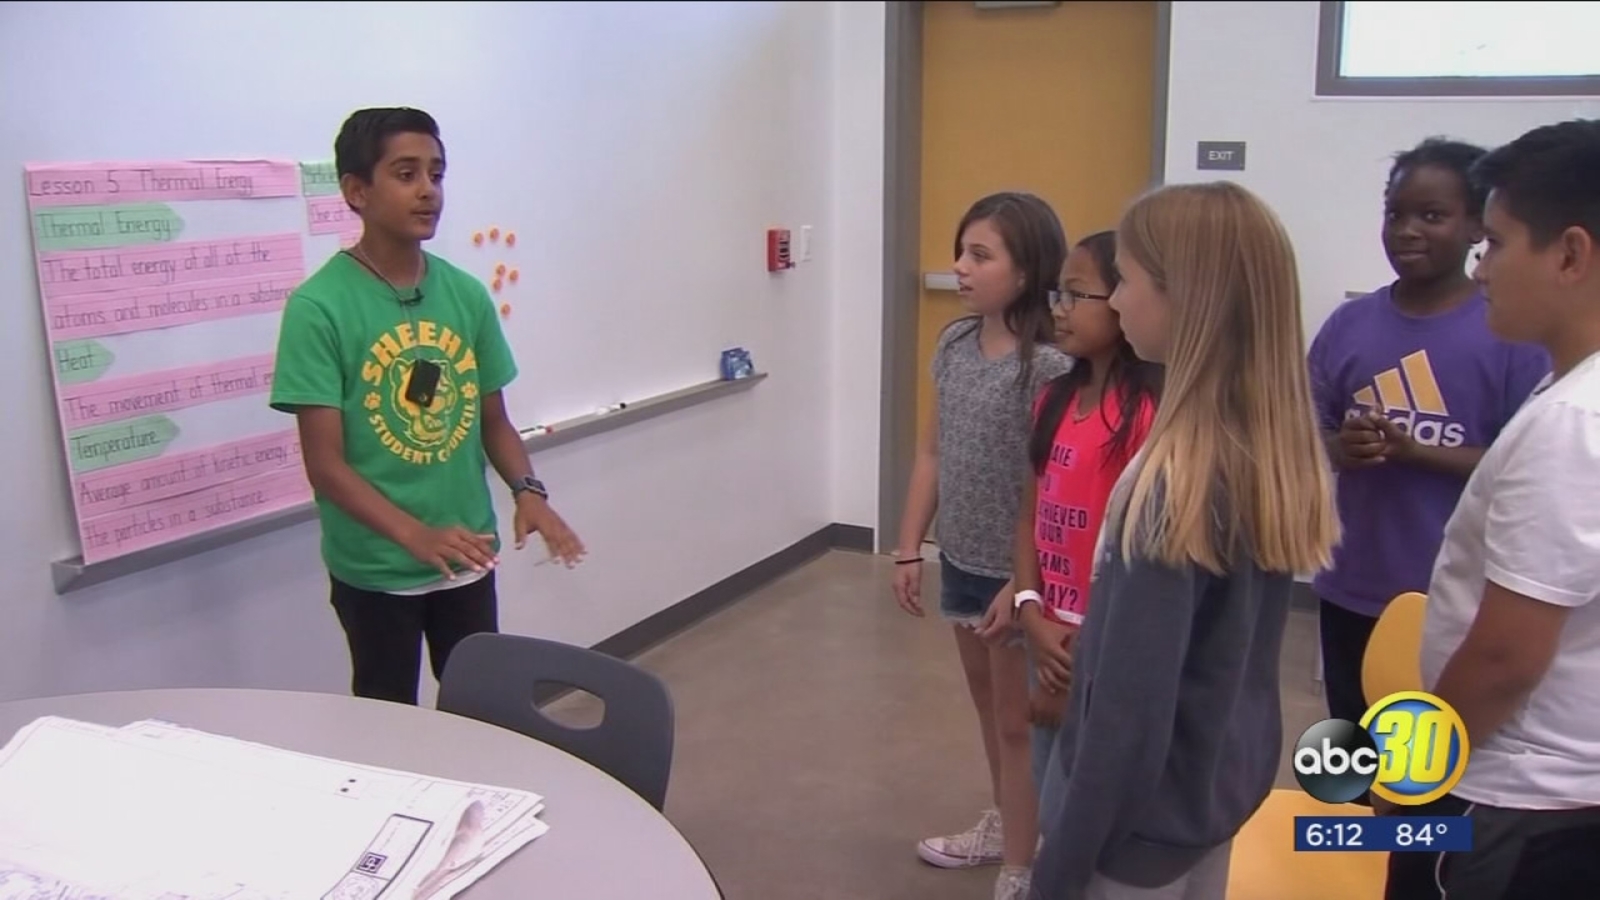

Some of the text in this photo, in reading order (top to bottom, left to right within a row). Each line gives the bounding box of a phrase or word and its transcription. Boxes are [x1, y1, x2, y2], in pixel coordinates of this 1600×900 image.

[1209, 150, 1235, 161] EXIT
[29, 167, 253, 197] Lesson 5 Thermal Energy
[36, 211, 171, 241] Thermal Energy
[42, 241, 271, 284] The total energy of all of the
[54, 305, 106, 330] atoms
[115, 297, 140, 321] and
[149, 290, 208, 316] molecules
[215, 294, 228, 308] in
[231, 293, 241, 306] a
[59, 348, 95, 373] Heat
[362, 320, 477, 387] SHEEHY
[64, 397, 100, 421] The
[108, 381, 181, 413] movement
[190, 376, 204, 400] of
[212, 368, 258, 395] thermal
[70, 429, 161, 462] Temperature
[369, 402, 476, 465] STUDENT CUNCIL
[80, 482, 132, 507] Average
[141, 467, 187, 491] amount
[193, 454, 206, 479] of
[214, 447, 253, 472] kinetic
[254, 446, 287, 468] energy
[114, 514, 165, 543] particles
[170, 510, 182, 525] in
[189, 509, 196, 522] a
[1040, 521, 1064, 545] OUR
[1037, 549, 1070, 576] AMS
[1045, 582, 1079, 611] AY?
